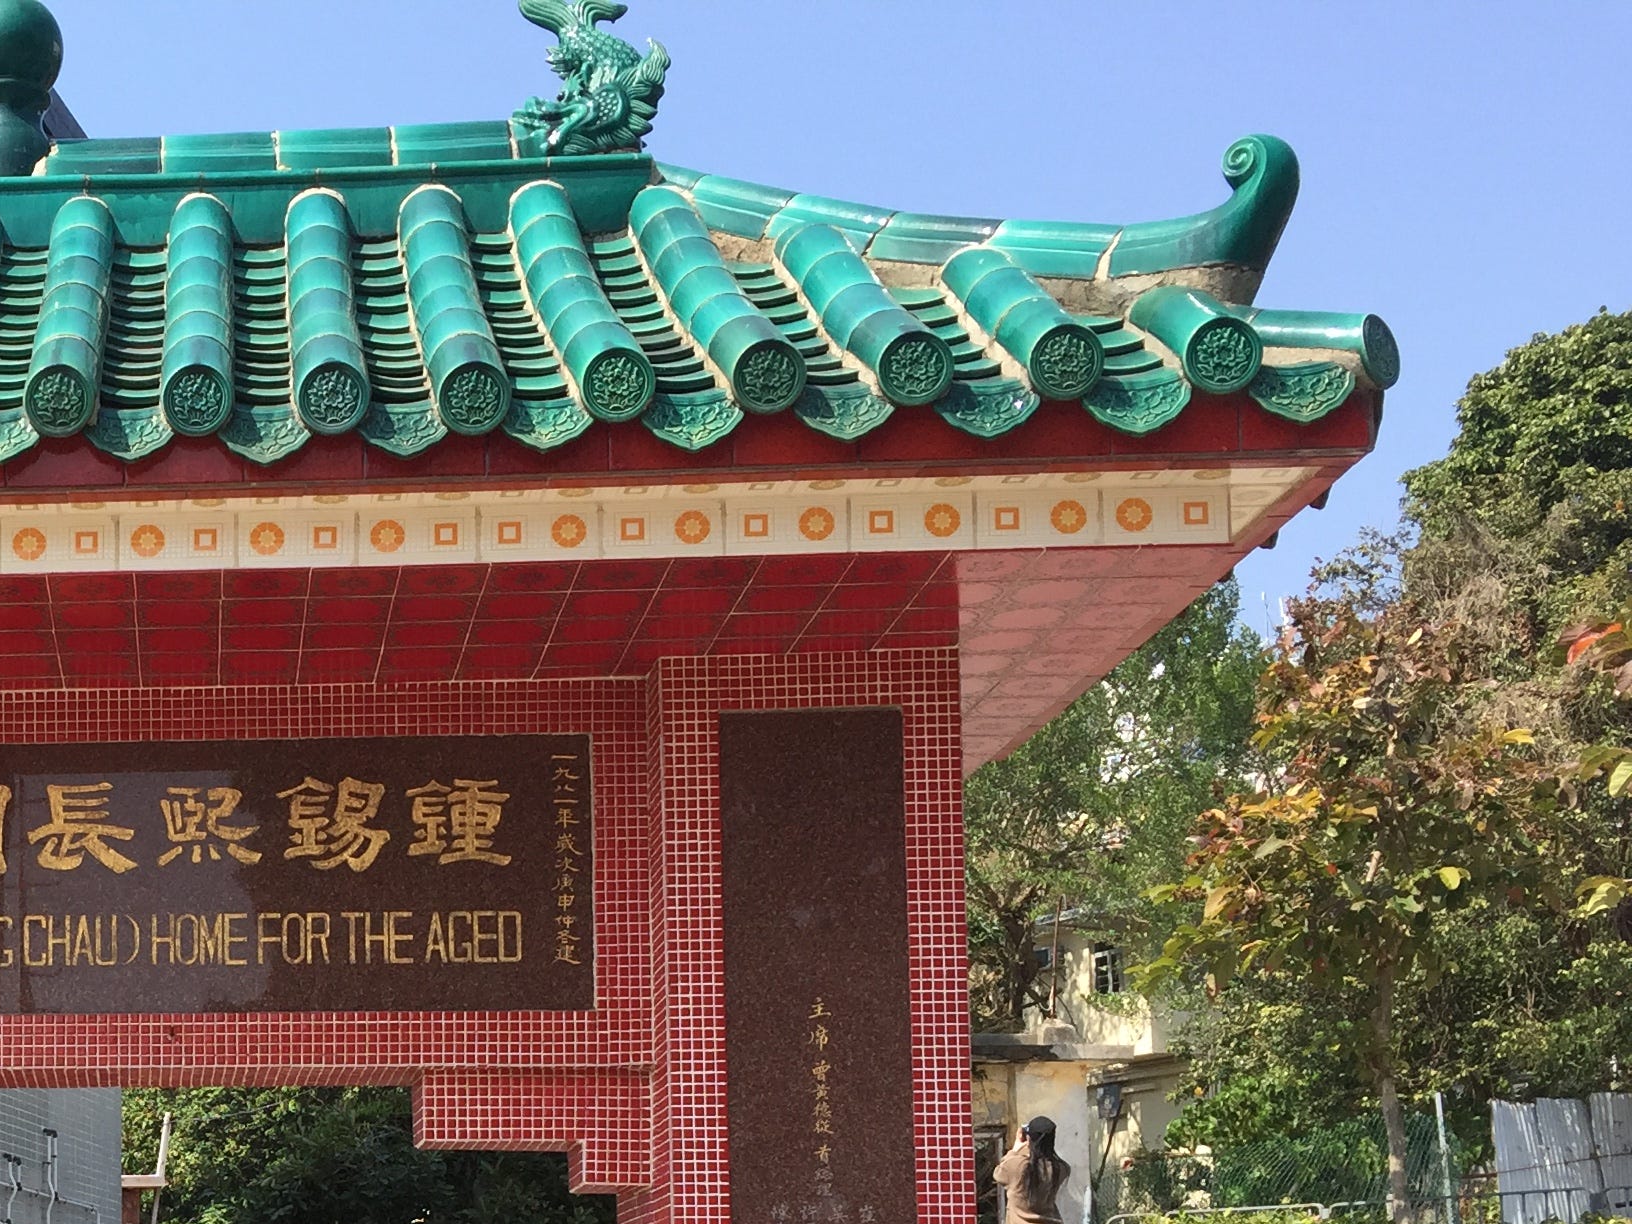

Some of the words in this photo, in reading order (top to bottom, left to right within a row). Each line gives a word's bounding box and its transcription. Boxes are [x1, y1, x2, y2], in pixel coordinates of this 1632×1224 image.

[22, 912, 140, 968] CHAU)
[151, 912, 248, 966] HOME
[257, 911, 330, 964] FOR
[341, 910, 414, 965] THE
[425, 910, 523, 964] AGED
